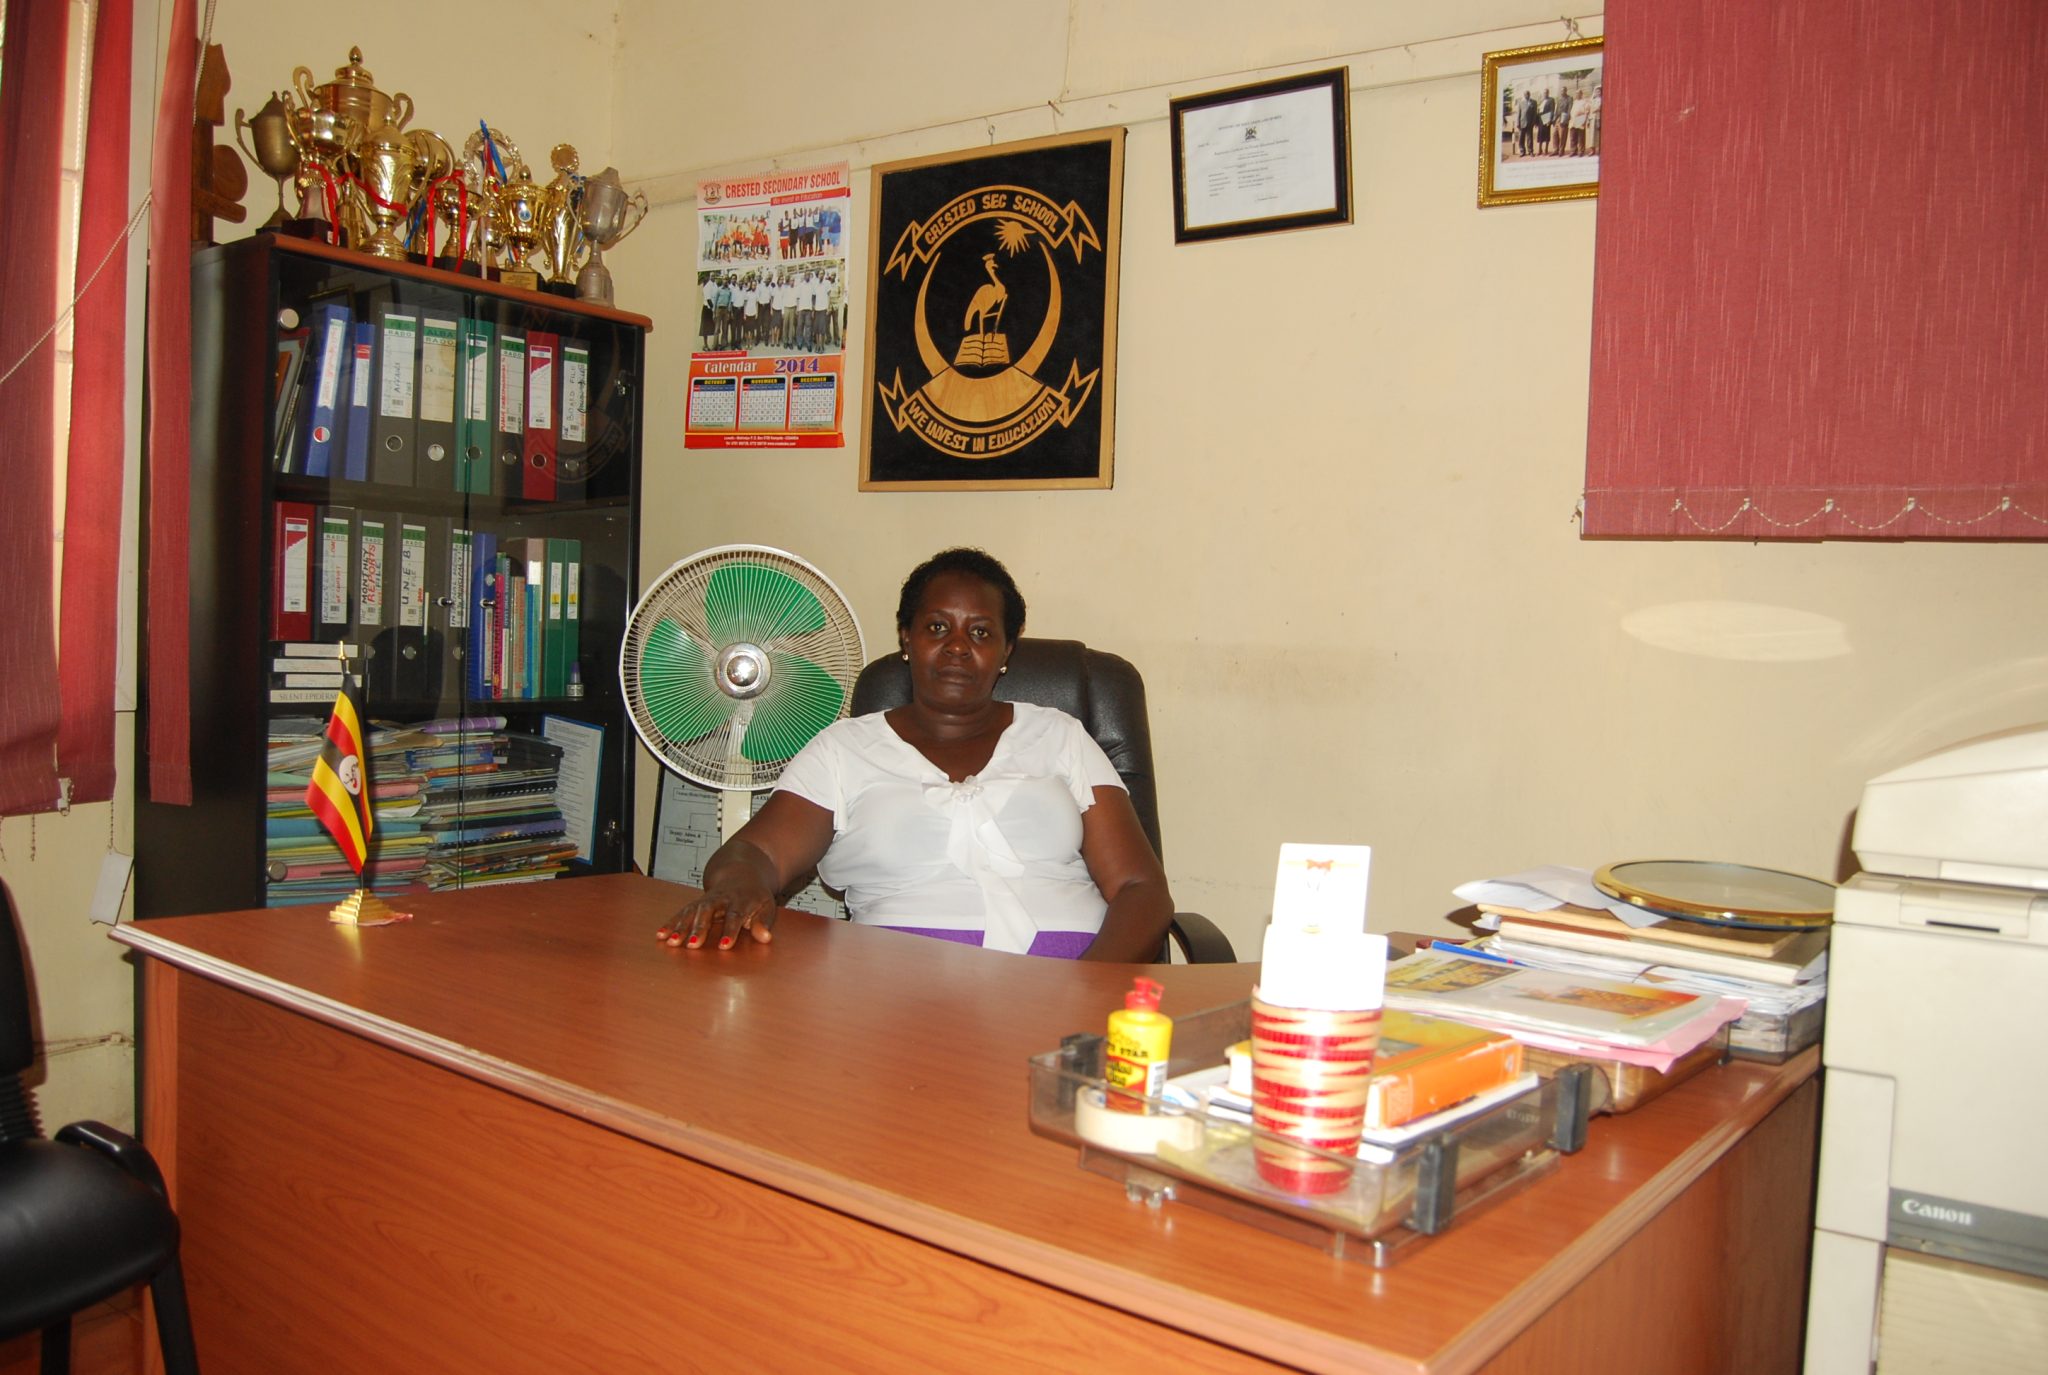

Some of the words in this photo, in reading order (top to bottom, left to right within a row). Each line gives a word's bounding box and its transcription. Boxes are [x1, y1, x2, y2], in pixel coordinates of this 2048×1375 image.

[725, 182, 761, 199] CRESTED
[762, 175, 809, 195] SECONDARY
[810, 171, 841, 189] SCHOOL
[924, 199, 976, 245] CRESTED
[982, 193, 1007, 210] SEC
[1012, 194, 1061, 233] SCHOOL
[704, 361, 757, 374] Calendar
[774, 357, 819, 374] 2014
[907, 400, 929, 428] WE
[925, 420, 969, 452] INVEST
[972, 436, 985, 453] IN
[988, 396, 1058, 450] EDUCATION
[361, 547, 369, 605] MONTHLY
[367, 543, 376, 603] REPORTS
[1901, 1198, 1974, 1226] Canon
